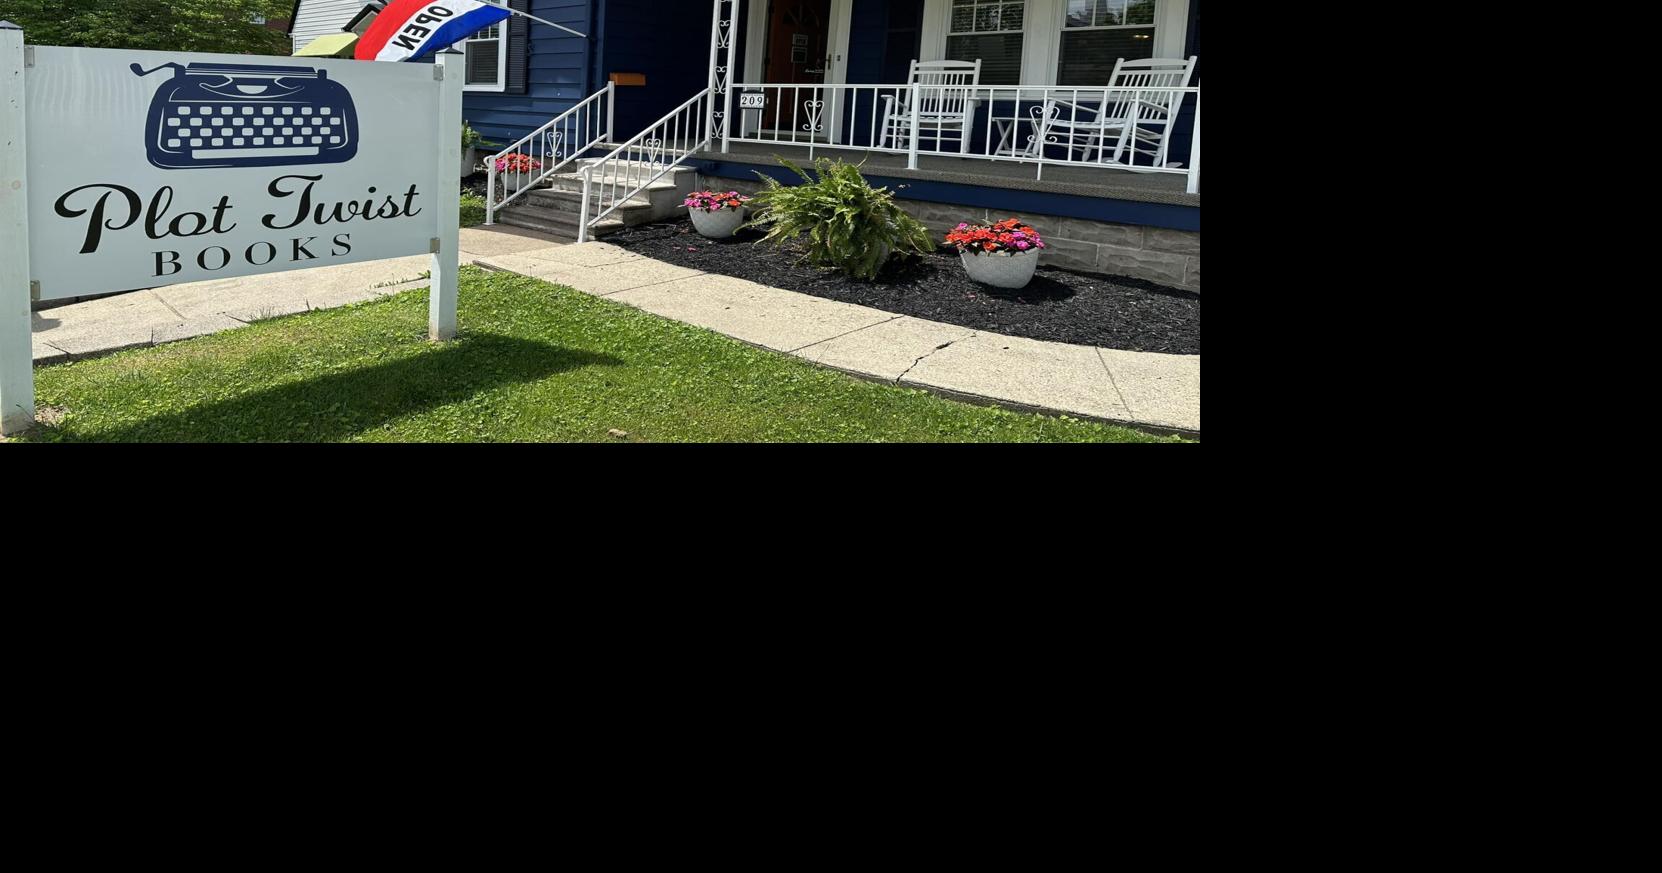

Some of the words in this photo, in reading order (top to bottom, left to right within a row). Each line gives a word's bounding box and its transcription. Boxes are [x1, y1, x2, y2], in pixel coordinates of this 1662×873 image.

[742, 96, 763, 105] 209
[54, 184, 236, 254] Plot
[262, 174, 422, 230] Twist
[152, 233, 351, 277] BOOKS
